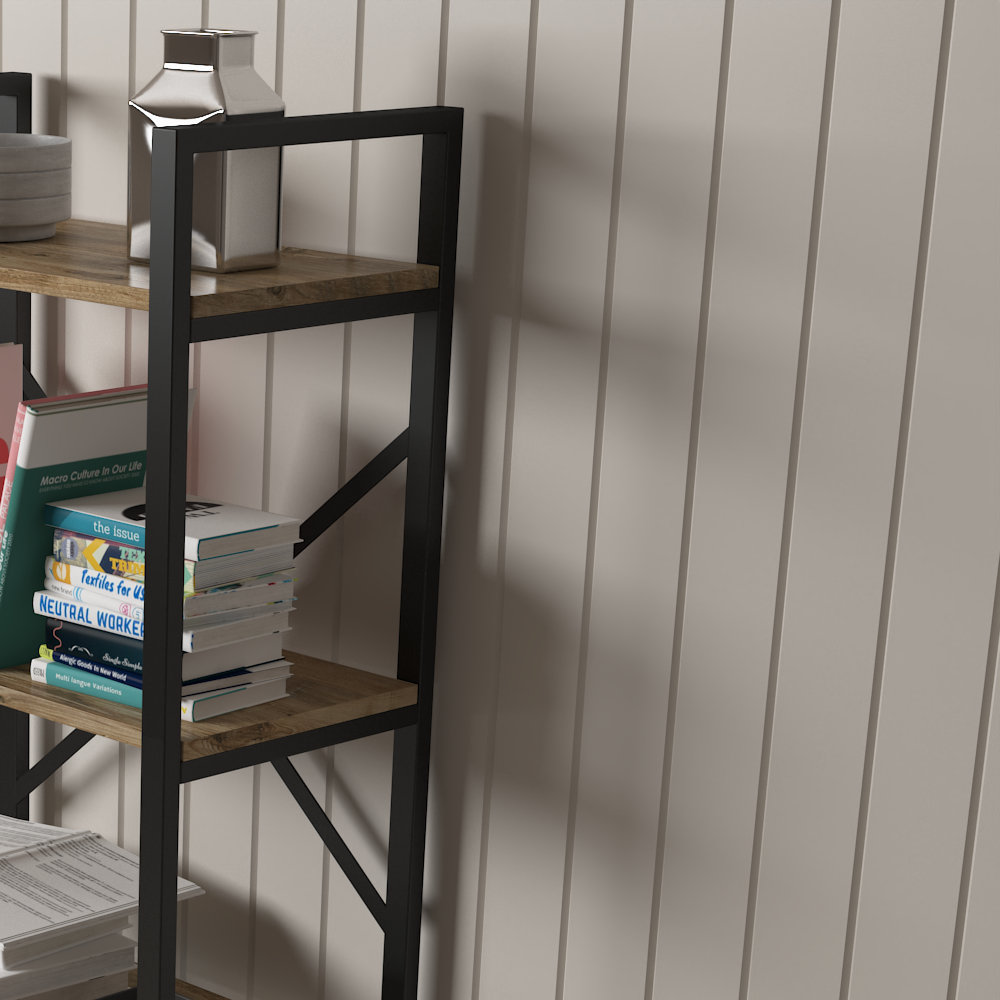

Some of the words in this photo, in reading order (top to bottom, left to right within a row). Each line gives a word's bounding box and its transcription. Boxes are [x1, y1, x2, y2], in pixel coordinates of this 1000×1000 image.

[40, 475, 69, 486] Macro
[70, 469, 101, 481] Culture
[102, 466, 110, 476] In
[112, 464, 127, 473] Our
[128, 460, 143, 471] Life
[93, 521, 111, 534] the
[113, 525, 140, 541] issue
[81, 569, 114, 592] Textiles
[116, 580, 131, 598] for
[39, 594, 93, 625] NEUTRAL
[77, 660, 93, 671] Goods
[100, 667, 112, 676] New
[112, 670, 127, 682] World
[55, 672, 70, 682] Multi
[92, 681, 122, 696] Variations
